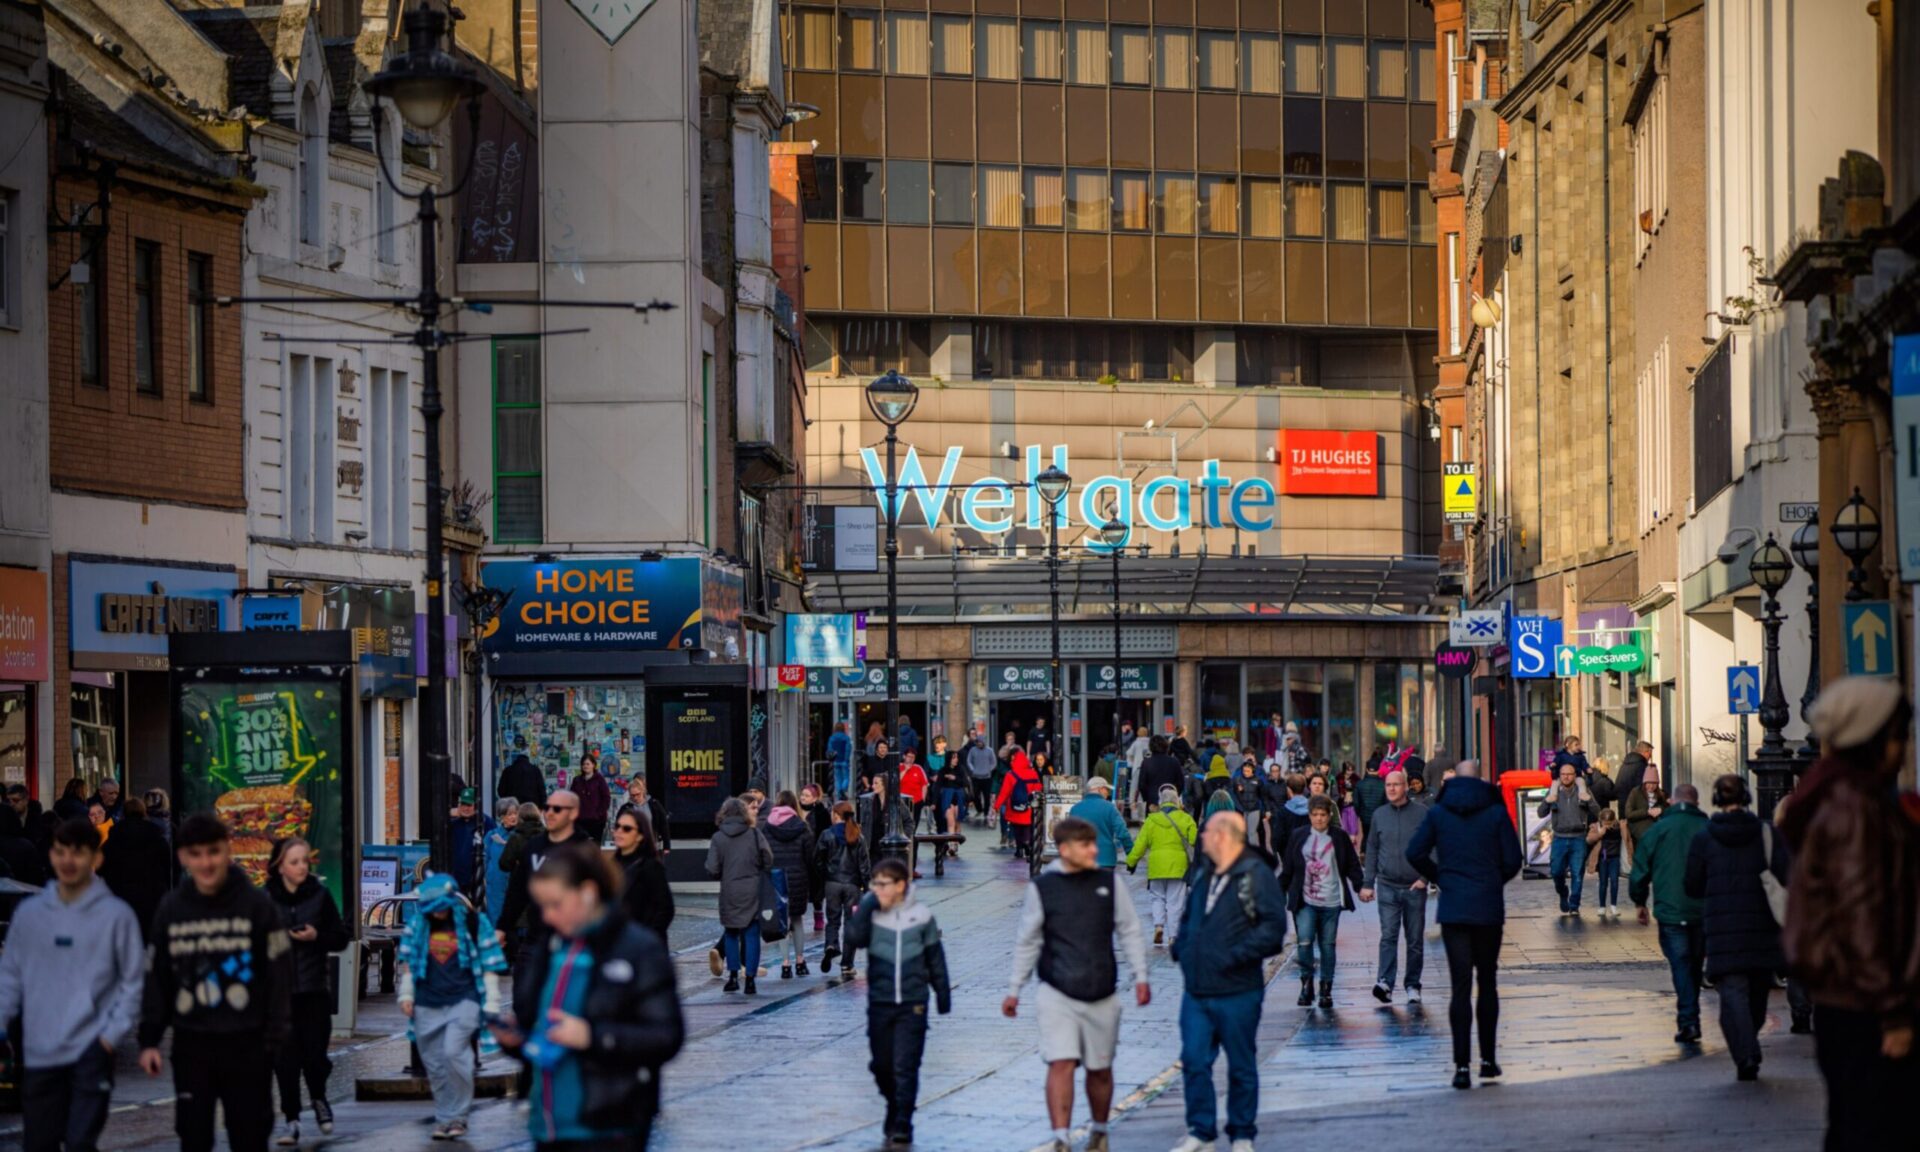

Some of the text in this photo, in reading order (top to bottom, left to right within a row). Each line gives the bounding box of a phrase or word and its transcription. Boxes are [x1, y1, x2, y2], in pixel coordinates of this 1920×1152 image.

[1291, 448, 1372, 465] TJ HUGHES
[1445, 464, 1461, 475] TO
[860, 443, 1276, 554] Wellgate
[535, 568, 634, 594] HOME
[520, 600, 650, 625] CHOICE
[1516, 619, 1543, 633] WH
[516, 631, 657, 643] HOMEWARE & HARDWARE
[1437, 652, 1471, 666] HMV
[1517, 632, 1545, 673] S
[1579, 653, 1638, 666] Specsavers
[782, 667, 801, 676] JUST
[1022, 669, 1046, 679] GYMS
[999, 683, 1009, 691] UP
[235, 730, 288, 753] ANY
[236, 749, 290, 774] SUB
[670, 749, 724, 772] HOME
[364, 869, 389, 878] ERO
